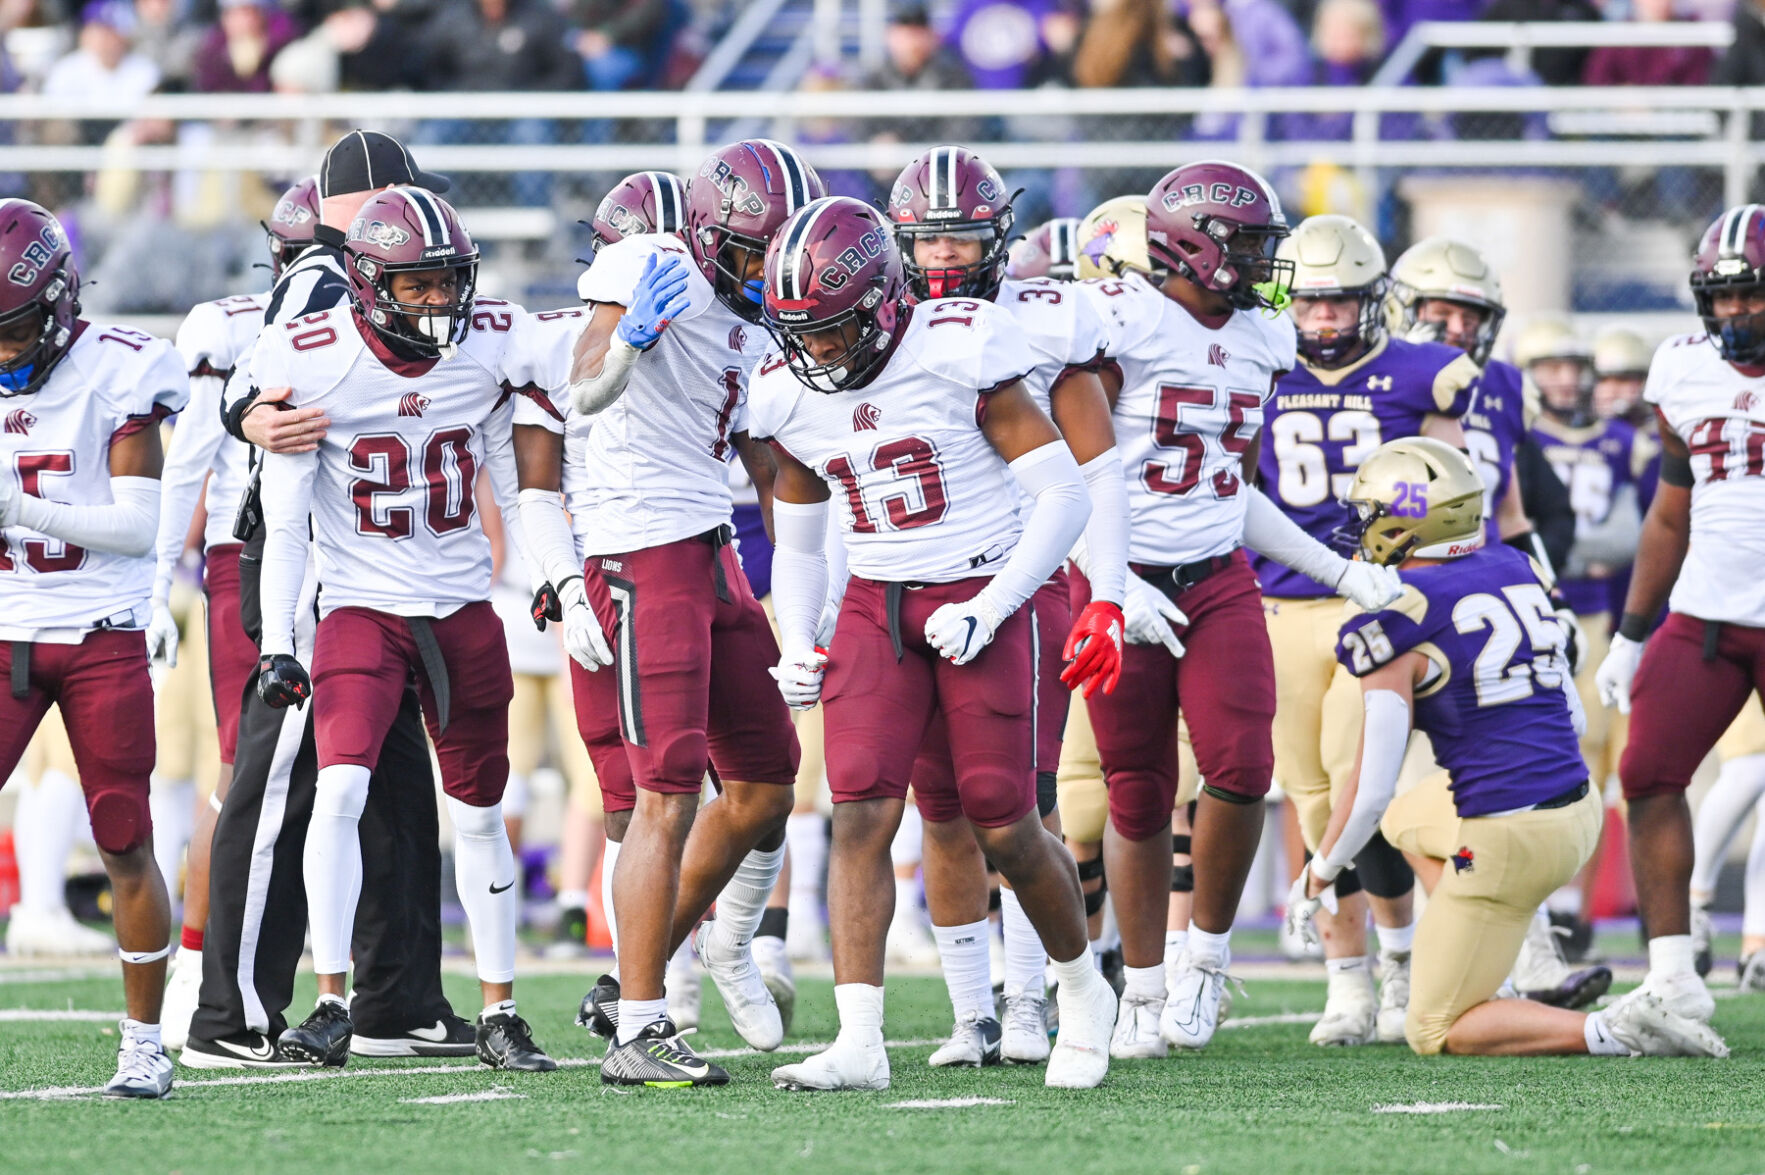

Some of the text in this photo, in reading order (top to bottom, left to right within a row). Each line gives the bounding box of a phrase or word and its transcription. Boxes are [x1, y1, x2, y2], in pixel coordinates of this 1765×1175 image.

[928, 300, 981, 329] 13
[1277, 393, 1373, 411] PLEASANT HILL
[1140, 381, 1264, 500] 55
[1271, 410, 1383, 507] 63
[347, 423, 478, 542] 20
[819, 433, 949, 533] 13
[1391, 481, 1428, 519] 25
[601, 558, 623, 573] LIONS
[1342, 619, 1394, 675] 25
[1452, 583, 1568, 708] 25
